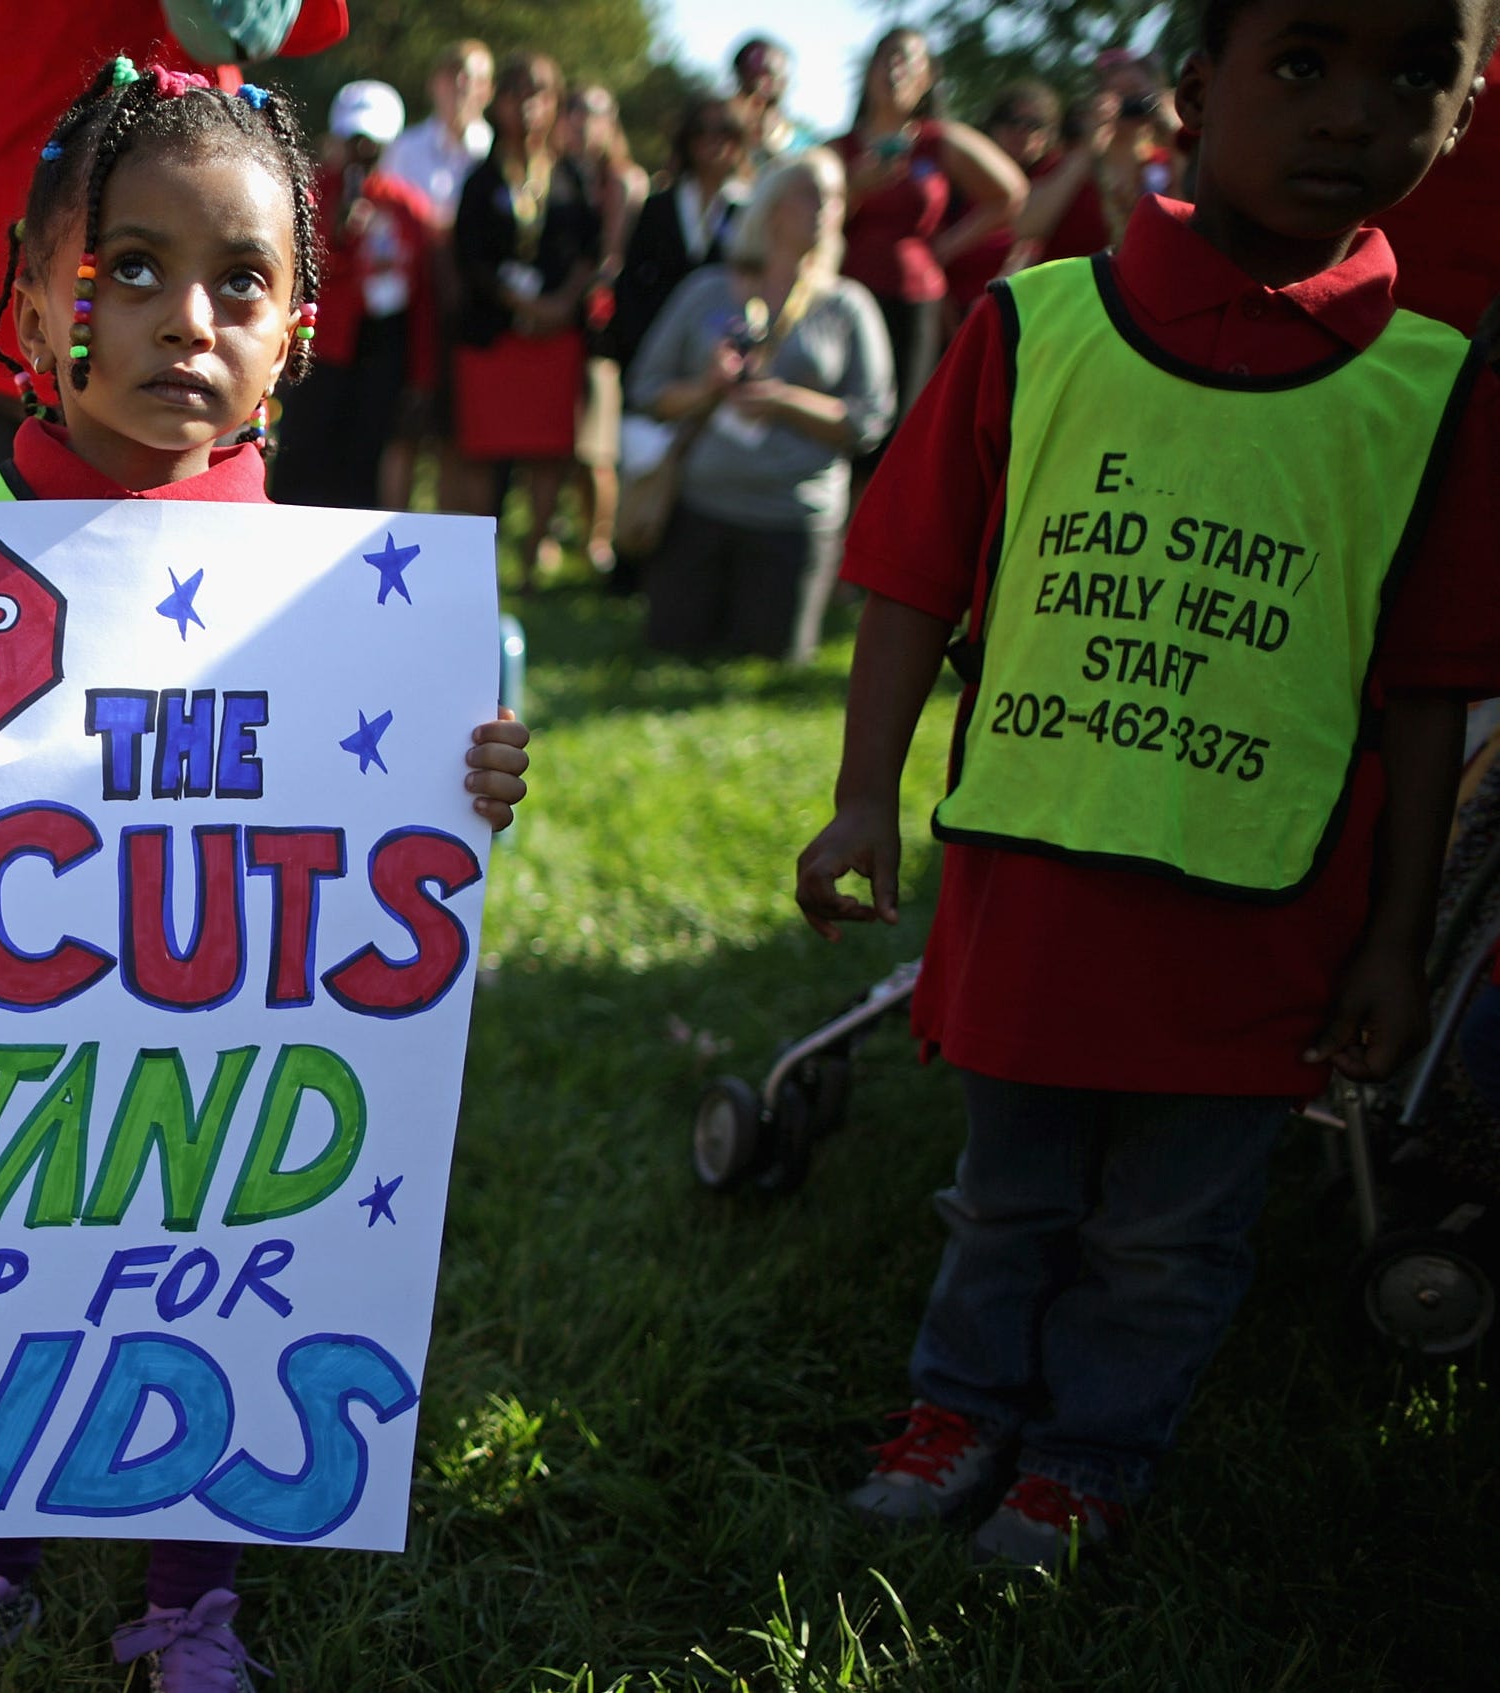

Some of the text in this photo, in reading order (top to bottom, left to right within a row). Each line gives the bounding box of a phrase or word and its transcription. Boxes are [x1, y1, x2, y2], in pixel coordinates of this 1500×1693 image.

[1038, 511, 1320, 597] HEAD START/
[1034, 571, 1291, 653] EARLY HEAD
[1081, 636, 1209, 697] START
[85, 688, 269, 800] THE
[86, 1238, 295, 1326] FOR
